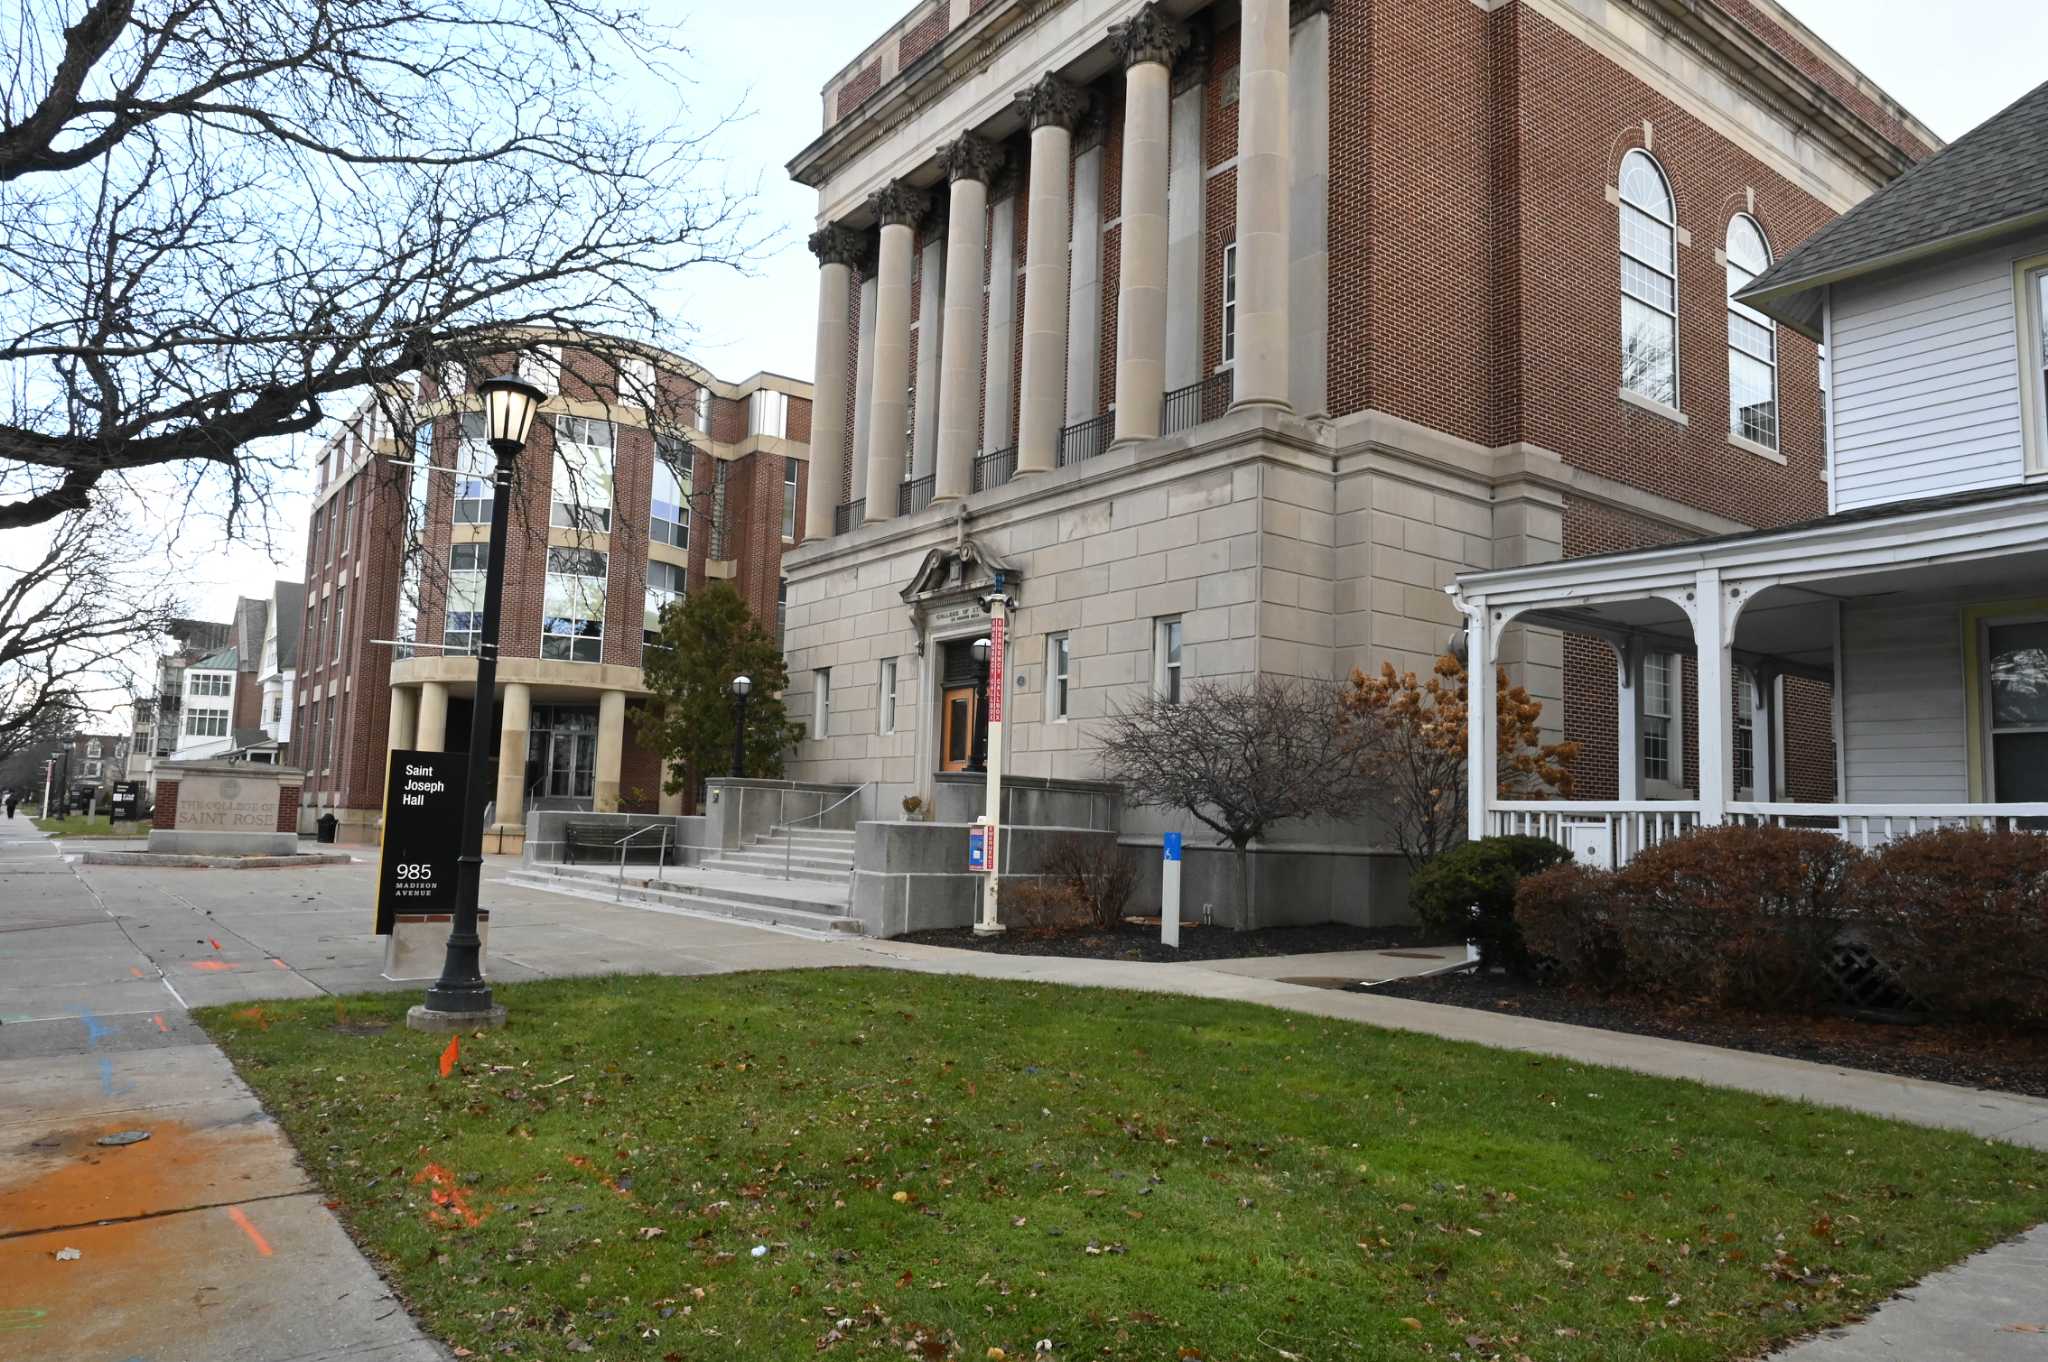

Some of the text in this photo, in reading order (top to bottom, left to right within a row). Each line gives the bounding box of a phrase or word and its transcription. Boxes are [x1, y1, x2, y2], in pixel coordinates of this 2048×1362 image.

[405, 764, 433, 777] Saint
[404, 779, 445, 793] Joseph
[180, 800, 204, 810] THE
[206, 801, 257, 811] COLLEGE
[402, 794, 425, 806] Hall
[179, 811, 274, 826] SAINT ROSE
[396, 863, 432, 880] 985
